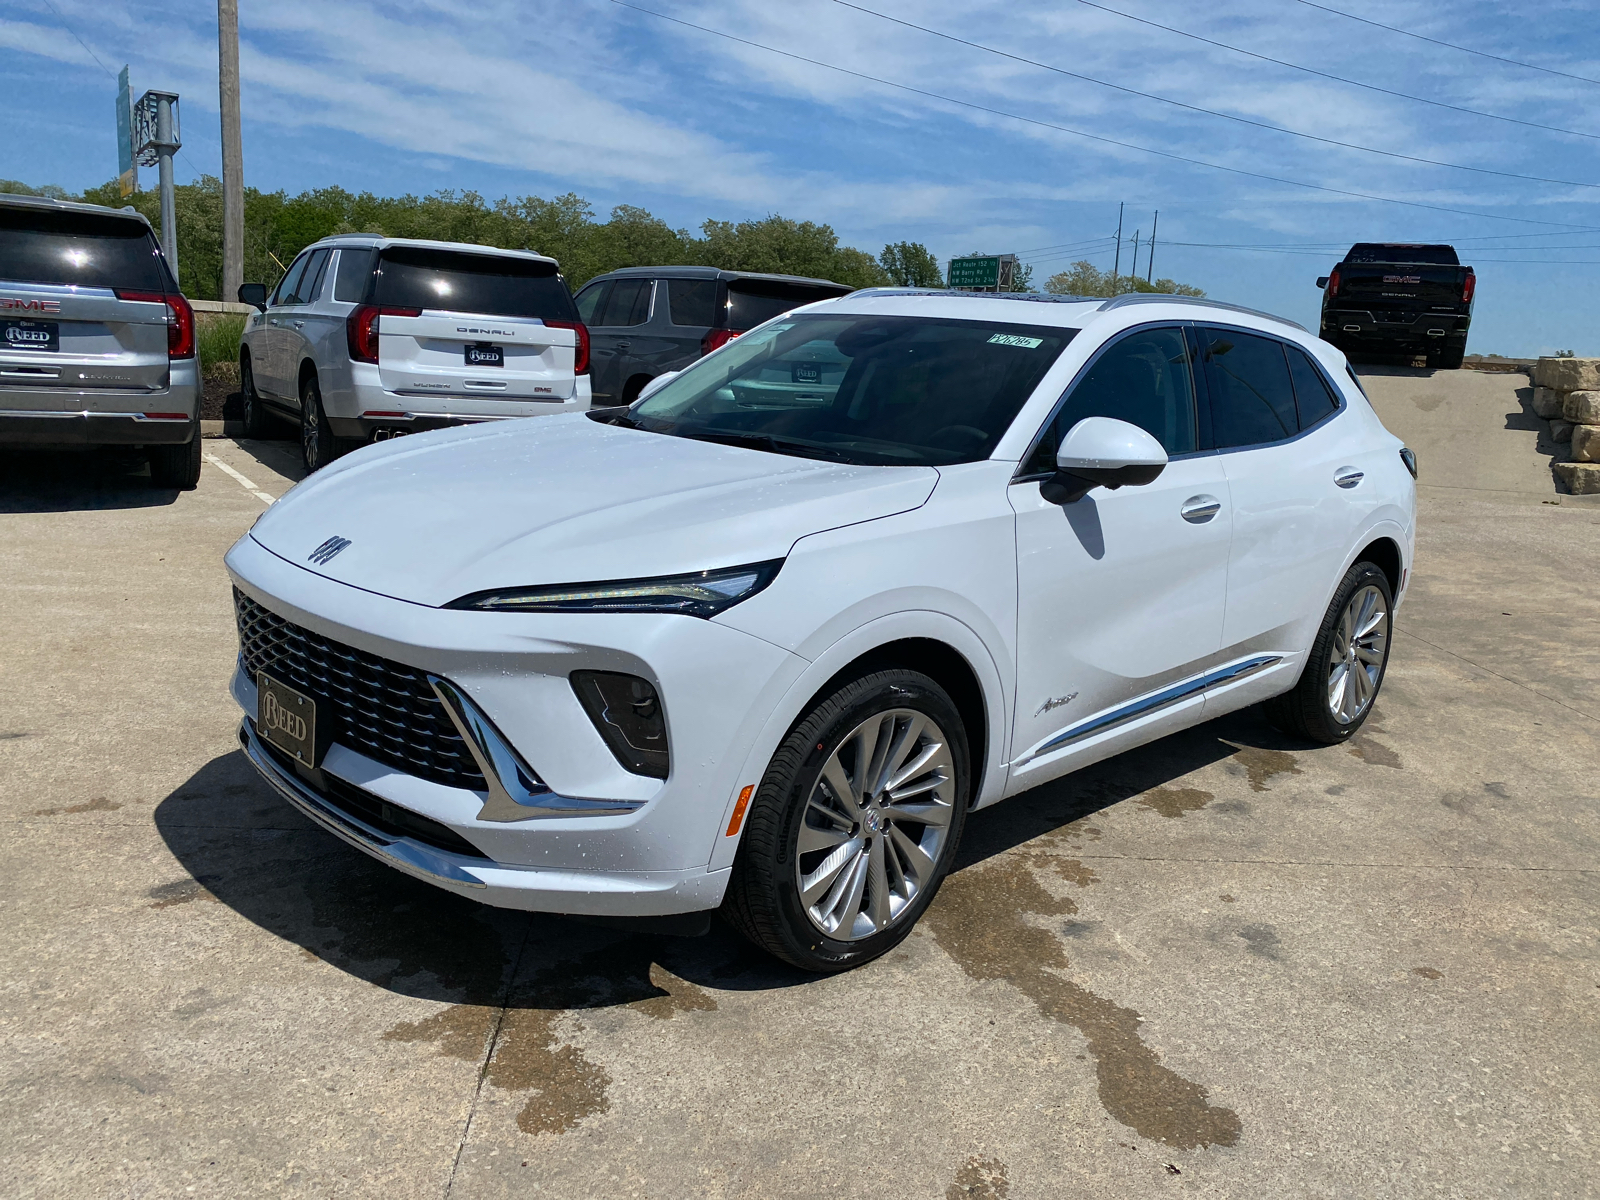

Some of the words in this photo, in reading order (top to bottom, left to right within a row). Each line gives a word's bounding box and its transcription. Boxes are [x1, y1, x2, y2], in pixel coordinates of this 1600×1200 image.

[961, 269, 975, 277] Barry
[1382, 275, 1421, 284] GMC
[0, 297, 61, 313] GMC
[5, 326, 50, 342] REED
[456, 327, 515, 336] DENALI
[469, 350, 500, 362] REED
[796, 368, 817, 377] REED
[263, 691, 307, 741] REED
